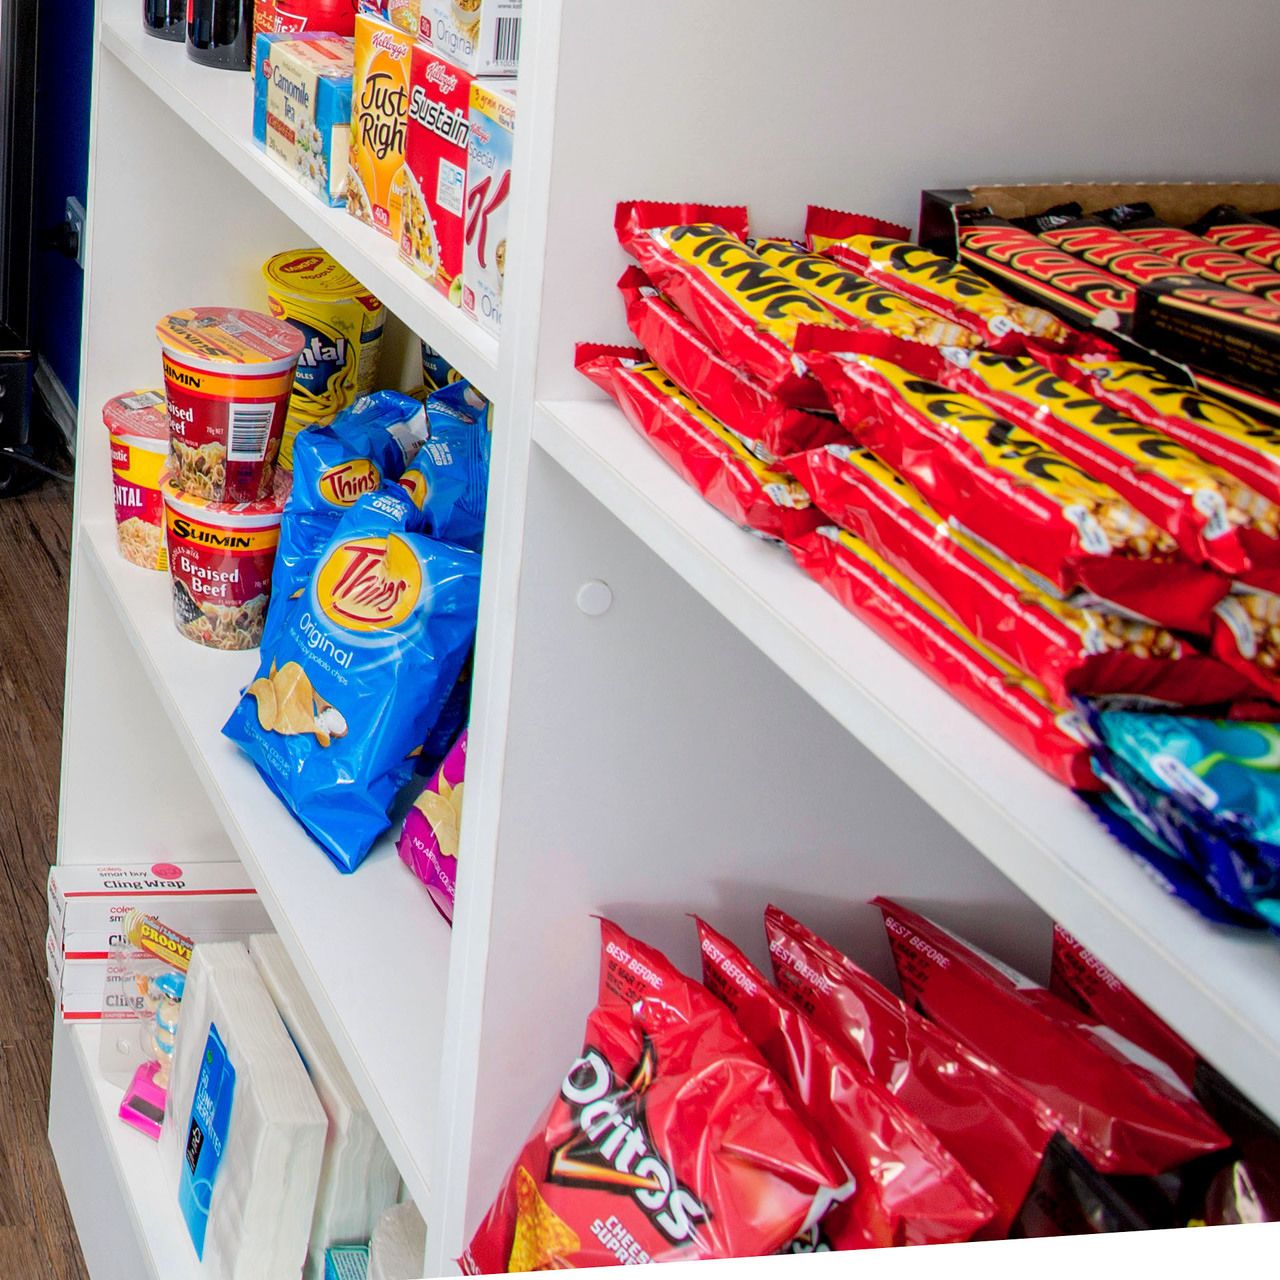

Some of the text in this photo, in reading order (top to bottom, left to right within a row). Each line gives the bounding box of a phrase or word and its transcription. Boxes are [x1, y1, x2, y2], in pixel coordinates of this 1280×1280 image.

[371, 30, 407, 60] Kellogg's
[436, 20, 476, 56] Original
[272, 66, 310, 107] Camomile
[360, 73, 408, 117] Just
[283, 97, 296, 122] Tea
[410, 87, 470, 149] Sustain
[325, 470, 377, 498] Thins
[172, 520, 251, 548] SUIMIN
[180, 556, 239, 584] Braised
[331, 545, 408, 621] Thins
[192, 577, 227, 598] Beef
[300, 612, 353, 669] Original
[103, 878, 185, 891] Cling Wrap
[606, 941, 631, 963] BEST
[561, 1051, 706, 1240] Doritos
